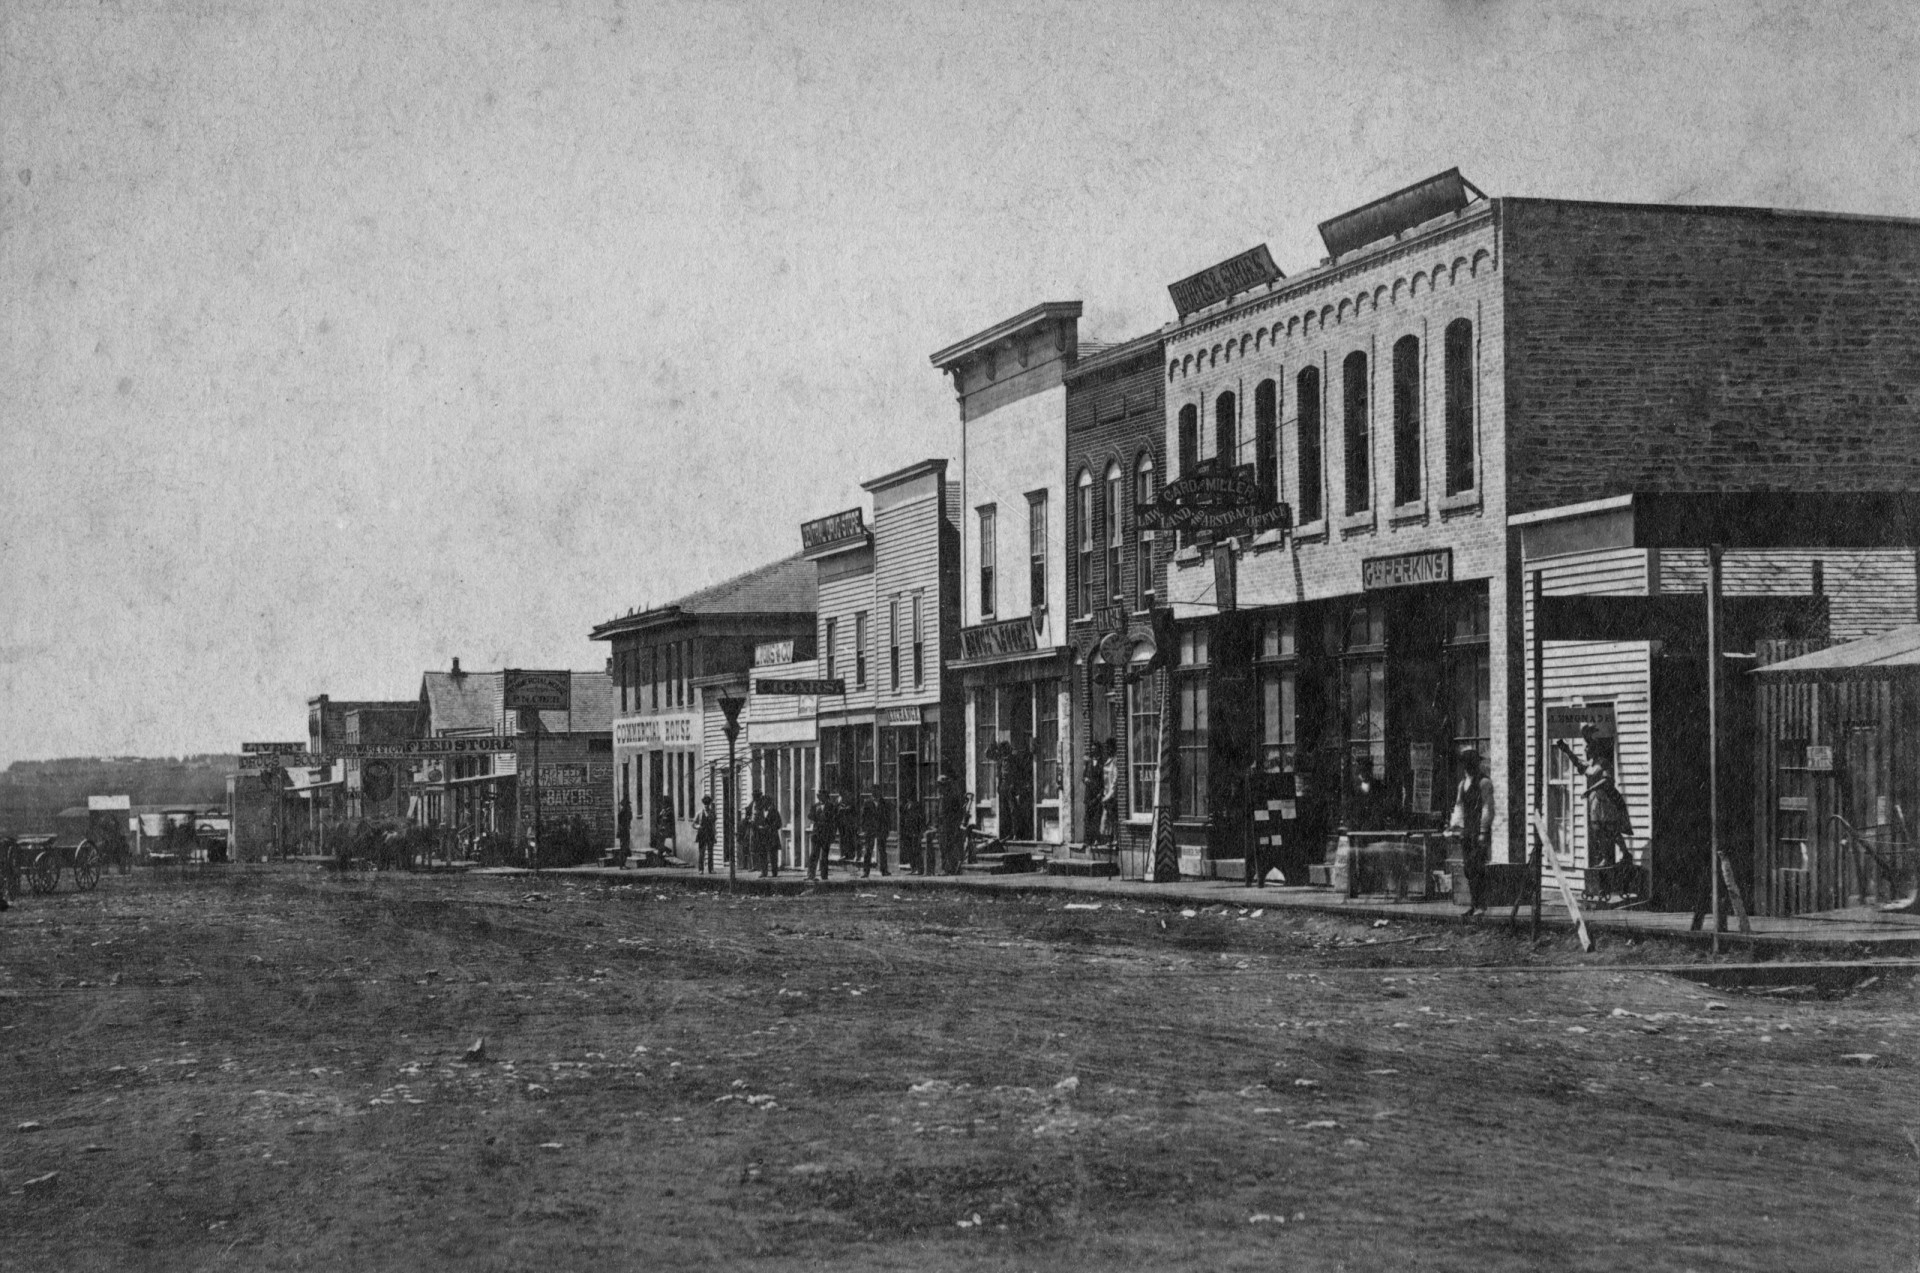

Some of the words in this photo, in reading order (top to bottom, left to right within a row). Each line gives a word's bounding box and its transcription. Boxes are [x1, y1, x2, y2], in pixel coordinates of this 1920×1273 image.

[1201, 505, 1256, 527] ABSTRACT
[1246, 504, 1287, 528] OFFICE
[617, 722, 661, 744] COMMERCIAL
[665, 719, 691, 741] HOUSE
[244, 742, 306, 752] LIVERY
[407, 739, 453, 752] FEED
[454, 738, 514, 751] STORE
